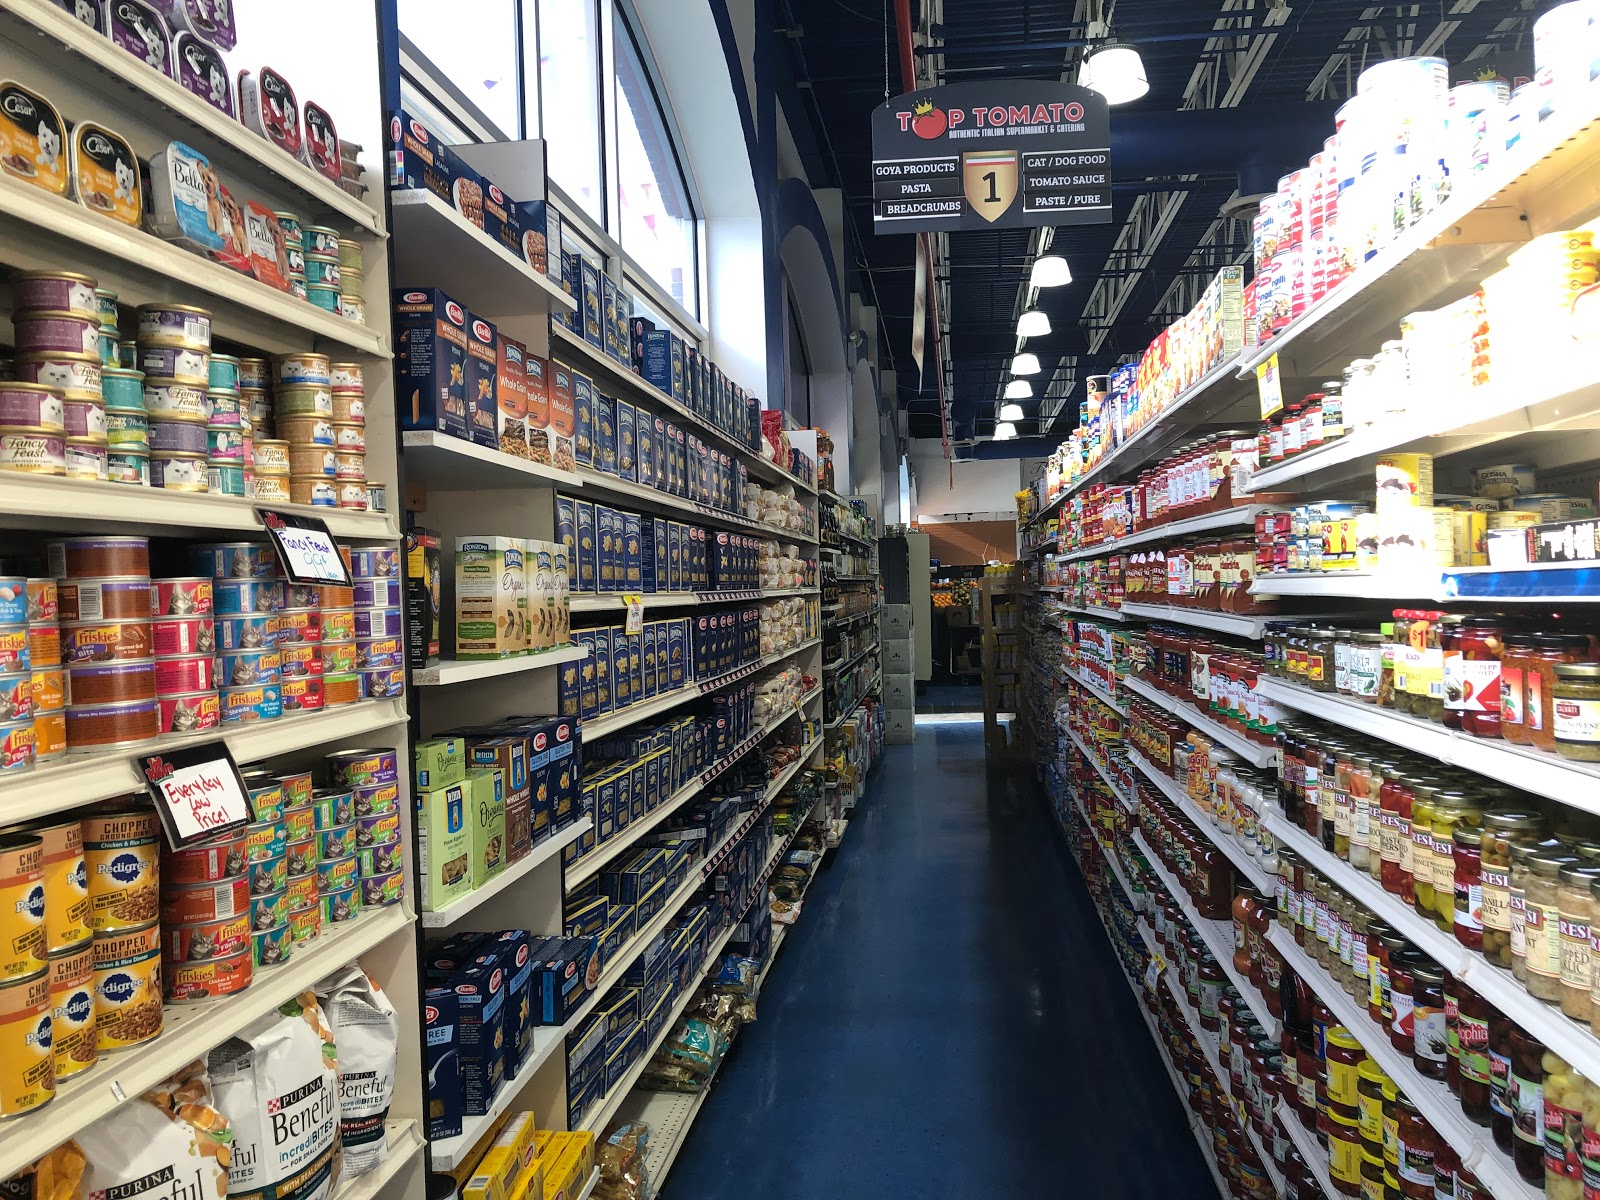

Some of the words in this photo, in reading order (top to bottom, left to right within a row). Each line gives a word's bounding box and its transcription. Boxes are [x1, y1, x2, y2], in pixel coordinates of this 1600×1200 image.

[118, 4, 143, 24] Cesar
[264, 75, 282, 93] Cesar
[4, 95, 34, 116] Cesar
[307, 109, 323, 125] Cesar
[972, 102, 1085, 127] TOMATO
[949, 127, 981, 139] AUTHENTIC
[982, 126, 1005, 138] ITALIAN
[1006, 124, 1048, 136] SUPERMARKET
[1056, 123, 1086, 132] CATERING
[86, 136, 111, 155] Cesar
[1027, 157, 1048, 168] CAT
[1049, 156, 1054, 167] /
[1055, 156, 1077, 166] DOG
[1078, 154, 1106, 165] FOOD
[876, 166, 902, 176] GOYA
[903, 162, 955, 174] PRODUCTS
[173, 160, 206, 195] Bella
[1029, 176, 1071, 187] TOMATO
[1073, 174, 1105, 185] SAUCE
[901, 184, 932, 194] PASTA
[982, 171, 1001, 203] 1
[1035, 196, 1066, 206] PASTE
[1067, 195, 1072, 205] /
[1074, 194, 1101, 205] PURE
[887, 201, 961, 214] BREADCRUMBS
[250, 219, 275, 246] Bella
[1272, 275, 1286, 287] ngilli
[442, 322, 457, 336] WHOLE
[456, 330, 467, 343] GRAIN
[469, 342, 485, 353] WHOLE
[484, 348, 496, 360] GRAIN
[500, 375, 516, 390] Whole
[516, 383, 527, 394] Grain
[173, 388, 201, 402] Fancy
[537, 394, 548, 405] Grain
[177, 399, 201, 408] Feast
[551, 398, 565, 411] Whole
[565, 406, 574, 416] Grain
[8, 437, 47, 451] Fancy
[12, 447, 45, 458] Feast
[262, 447, 285, 458] Fancy
[266, 455, 285, 463] Feast
[1481, 471, 1508, 480] GEISHA
[255, 479, 278, 488] Fancy
[257, 486, 278, 494] Feast
[1475, 503, 1498, 512] GEISHA
[278, 532, 312, 553] Fancy
[305, 536, 330, 553] Feast
[463, 544, 488, 552] RONZONI
[278, 617, 307, 629] Friskies
[79, 630, 119, 645] Friskies
[1412, 629, 1425, 648] $1
[78, 649, 95, 658] Bits
[373, 643, 396, 654] Friskies
[284, 650, 312, 662] Friskies
[371, 655, 388, 663] Shreds
[259, 669, 276, 679] Shreds
[230, 694, 262, 706] Friskies
[228, 706, 250, 716] Shreds
[12, 749, 30, 762] Filets
[352, 763, 379, 773] Friskies
[189, 796, 211, 812] Low
[505, 792, 520, 805] WHOLE
[192, 805, 231, 829] Price!
[104, 819, 153, 834] CHOPPED
[99, 833, 131, 841] GROUND
[1412, 832, 1433, 846] RESI
[100, 841, 123, 849] Chicken
[1432, 841, 1453, 855] RESI
[97, 861, 149, 874] Pedigree
[1482, 870, 1509, 887] RESI
[16, 896, 44, 913] Pedig
[95, 901, 107, 909] REAL
[106, 897, 126, 906] CHICKEN
[1483, 896, 1510, 910] ANILLA
[1511, 896, 1526, 910] ESI
[1482, 905, 1500, 917] IVES
[222, 924, 248, 939] Friskies
[1560, 920, 1591, 939] RESI
[94, 935, 146, 955] CHOPPED
[124, 944, 149, 957] DINNER
[220, 940, 238, 952] Filets
[132, 954, 149, 963] Dinner
[1561, 949, 1590, 964] PPED
[1562, 959, 1585, 975] RLIC
[53, 971, 82, 984] GROUND
[67, 979, 79, 988] With
[178, 970, 213, 983] Friskies
[176, 986, 195, 995] Filets
[56, 1038, 68, 1049] MADE
[68, 1033, 81, 1044] WITH
[428, 1029, 446, 1039] REE
[1459, 1025, 1488, 1046] ophia
[54, 1045, 66, 1055] REAL
[66, 1037, 84, 1050] CHICKEN
[1490, 1060, 1507, 1074] phia
[344, 1071, 377, 1080] PURINA
[283, 1078, 323, 1107] PURINA
[340, 1075, 388, 1098] Beneful
[1328, 1089, 1342, 1098] PPERS
[270, 1080, 335, 1147] Beneful
[1545, 1114, 1564, 1127] phia
[350, 1124, 382, 1136] INGREDIENT
[1358, 1126, 1377, 1136] PPERS
[1383, 1117, 1395, 1132] CINI
[279, 1117, 334, 1164] incrediBITES
[290, 1157, 303, 1169] FOR
[303, 1146, 318, 1161] SMALL
[317, 1136, 329, 1152] DOGS
[1583, 1142, 1600, 1156] phia
[282, 1178, 300, 1193] WITH
[299, 1168, 312, 1184] REAL
[310, 1153, 333, 1176] CHICKEN
[1330, 1166, 1345, 1176] PPERS
[108, 1169, 172, 1200] PURINA
[1361, 1179, 1380, 1195] CINI
